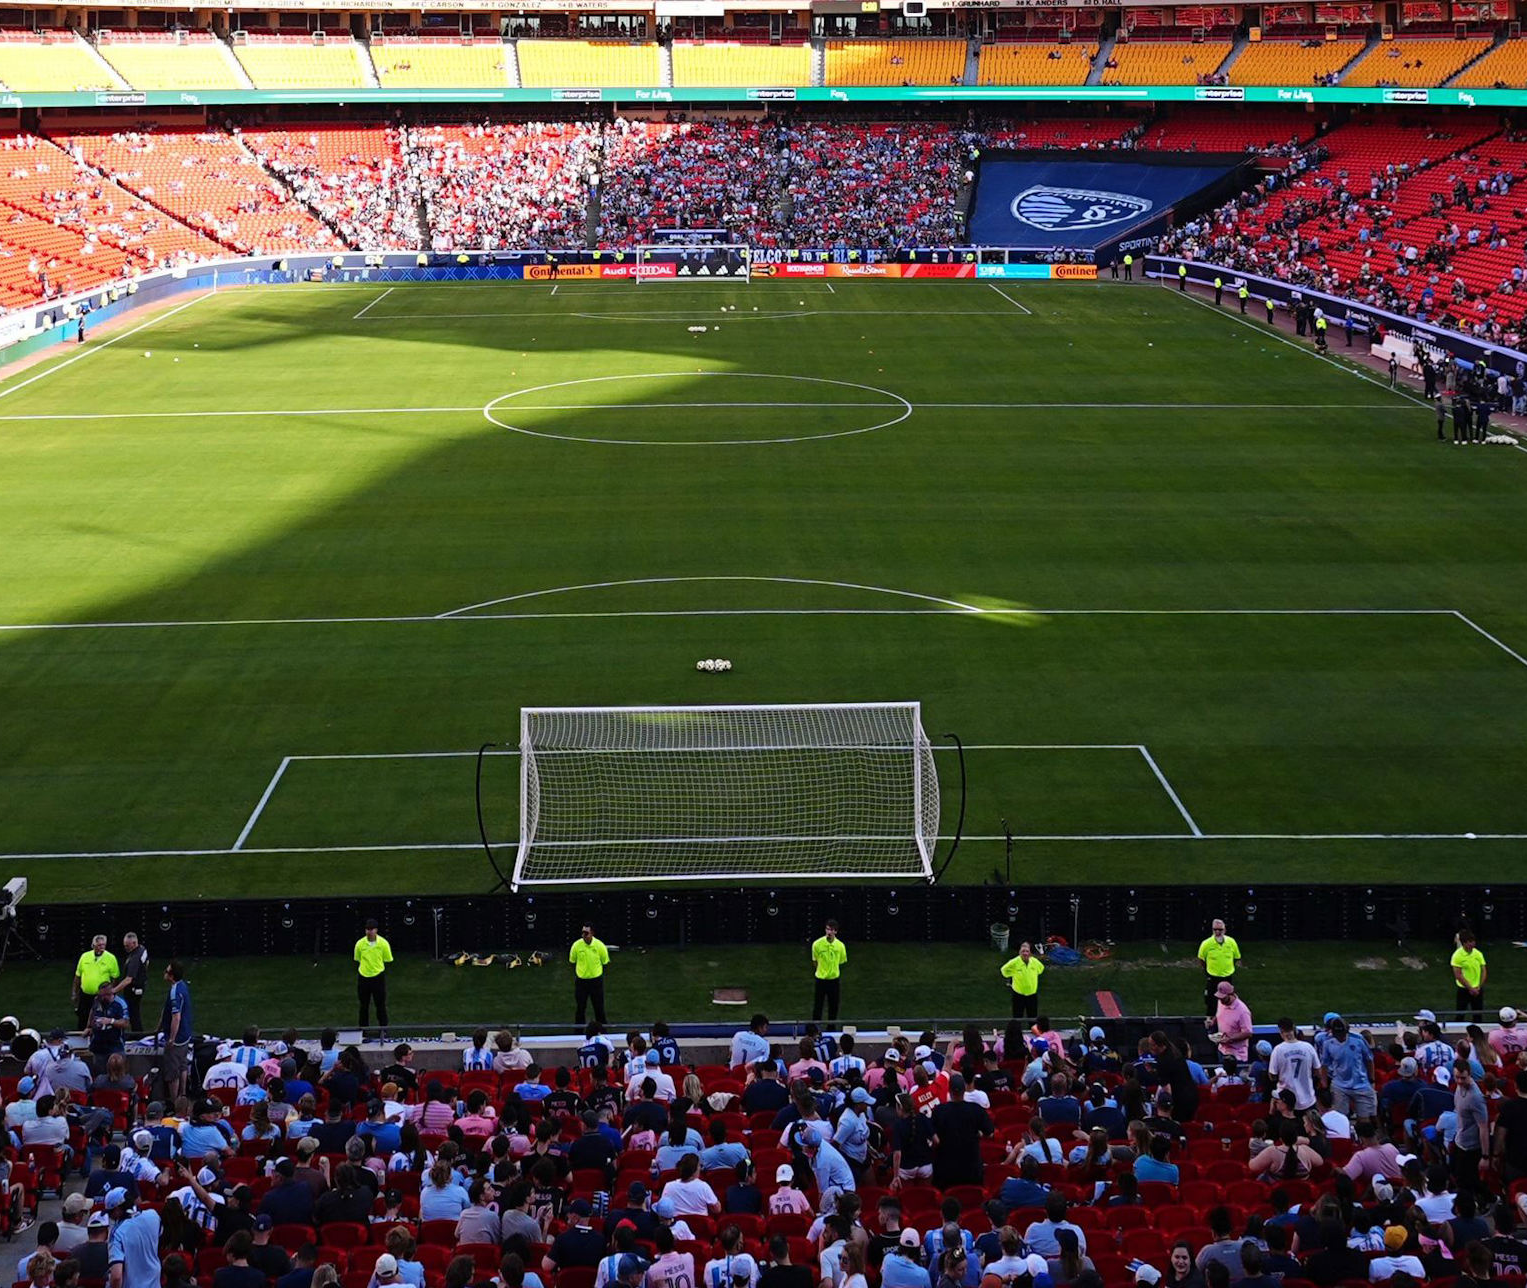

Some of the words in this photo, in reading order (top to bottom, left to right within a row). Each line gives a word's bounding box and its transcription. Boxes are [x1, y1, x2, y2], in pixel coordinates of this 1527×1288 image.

[1119, 236, 1159, 252] SPORTING
[802, 251, 812, 261] TO
[603, 267, 626, 275] Audi
[663, 1047, 675, 1064] 9
[1290, 1058, 1302, 1078] 7
[1494, 1253, 1519, 1263] MESSI
[664, 1264, 685, 1276] MESSI
